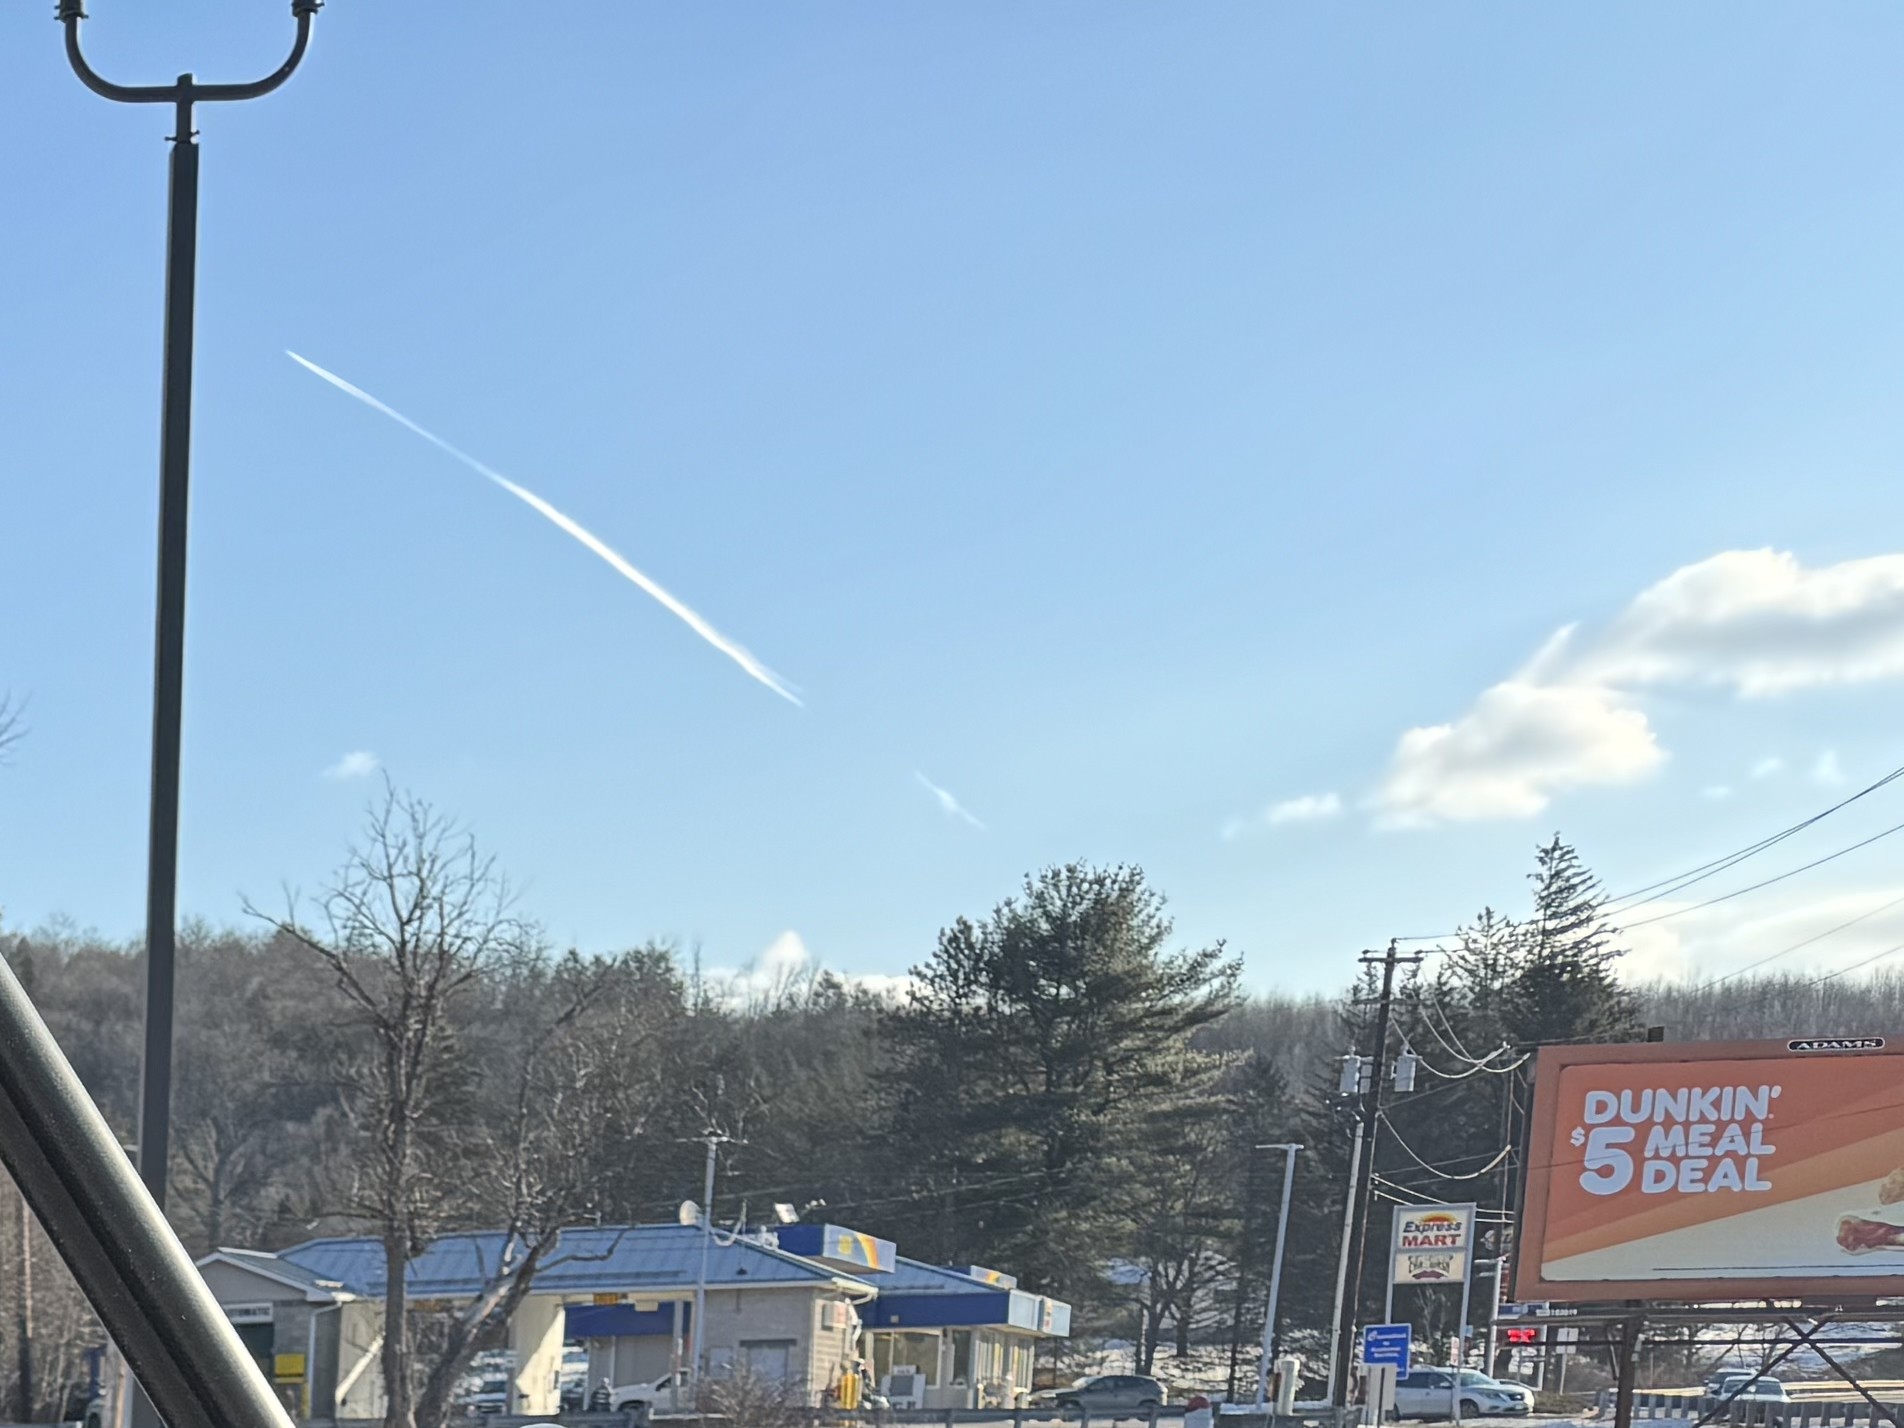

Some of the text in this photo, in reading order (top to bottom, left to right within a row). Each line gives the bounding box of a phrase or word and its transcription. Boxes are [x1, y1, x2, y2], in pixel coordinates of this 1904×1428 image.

[1796, 1040, 1876, 1050] ADAMS
[1583, 1085, 1782, 1124] DUNKIN'
[1570, 1123, 1776, 1196] $5 MEAL
[1641, 1157, 1772, 1194] DEAL
[1403, 1221, 1462, 1234] Express
[1402, 1234, 1461, 1247] MART
